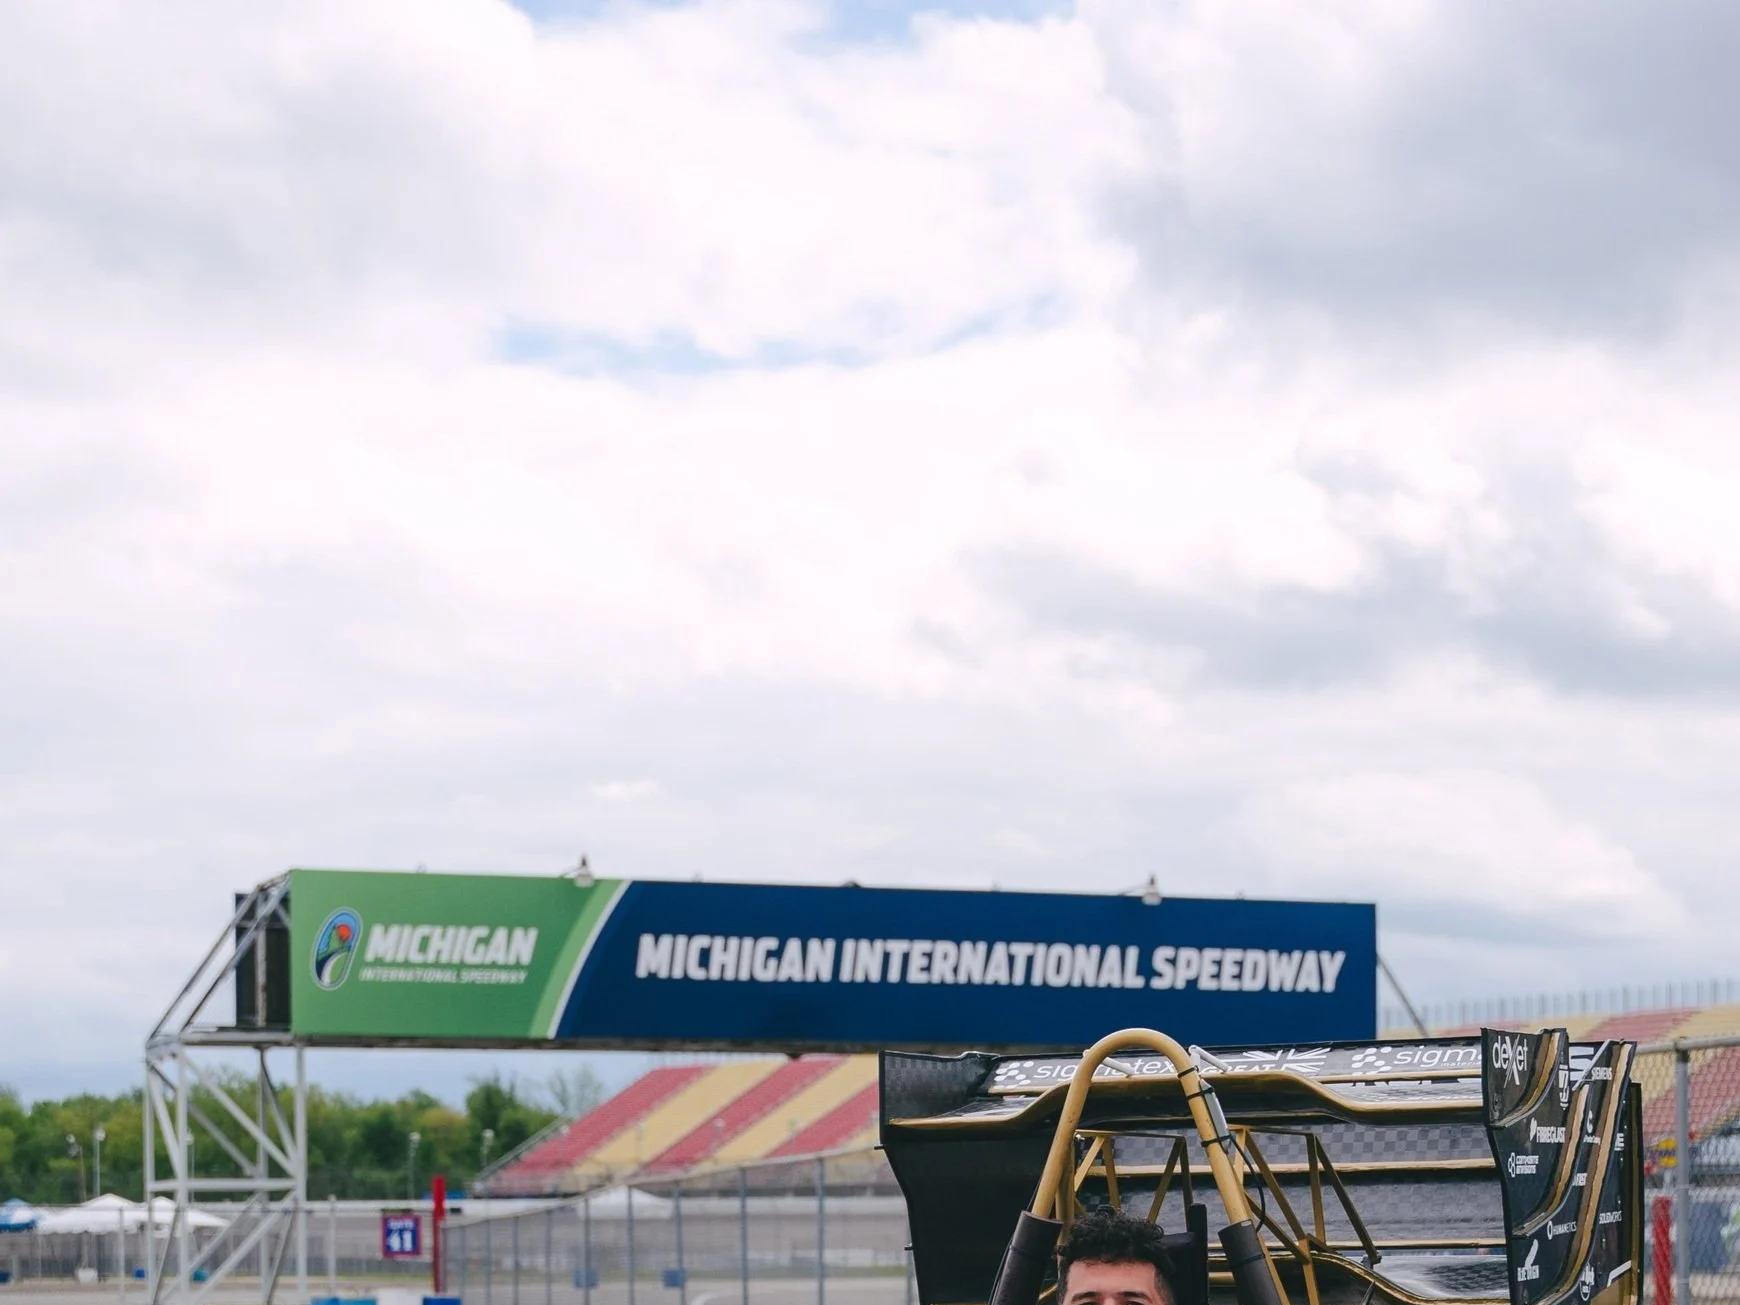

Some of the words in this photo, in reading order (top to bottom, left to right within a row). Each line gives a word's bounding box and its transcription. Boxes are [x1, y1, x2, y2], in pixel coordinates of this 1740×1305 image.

[364, 924, 538, 966] MICHIGAN
[635, 932, 837, 982] MICHIGAN
[839, 938, 1145, 988] INTERNATIONAL
[1150, 945, 1346, 993] SPEEDWAY
[459, 968, 528, 984] SPEEDWAY
